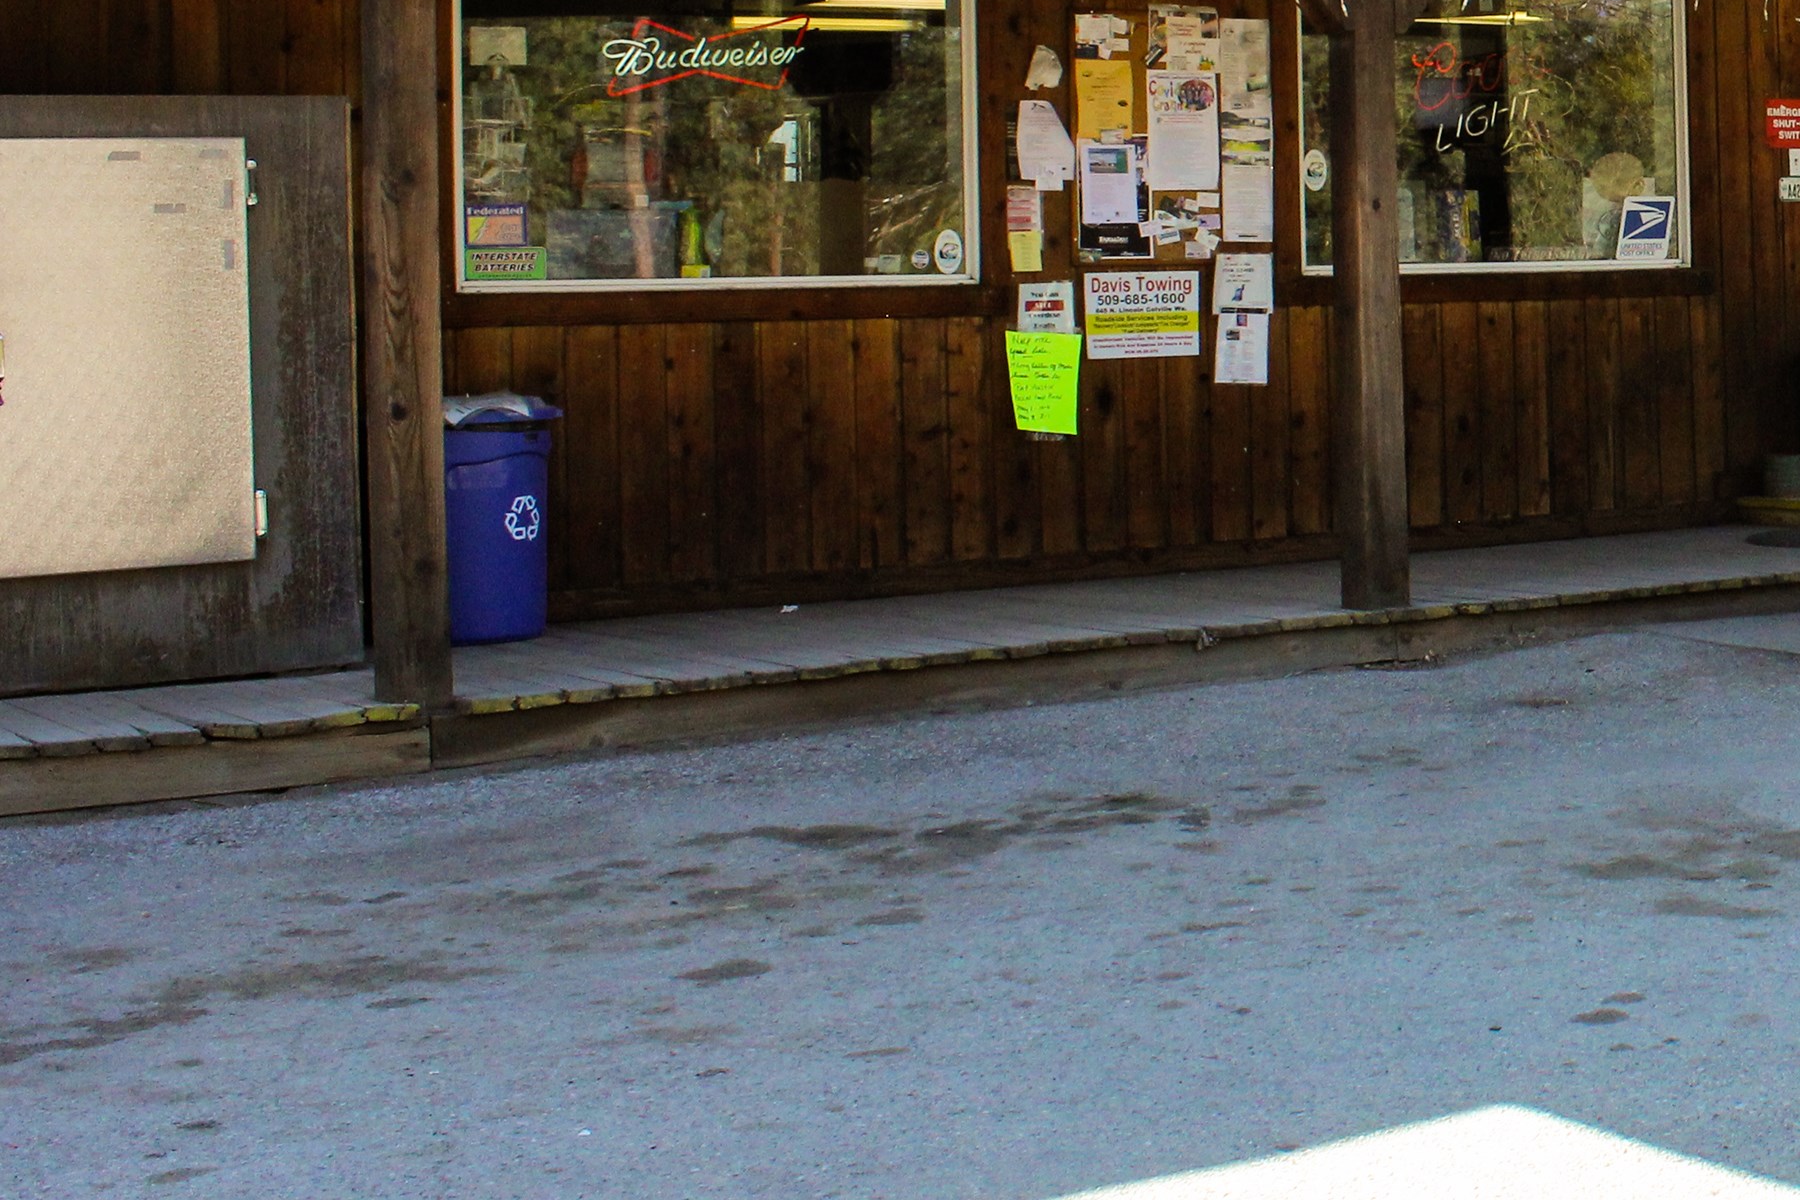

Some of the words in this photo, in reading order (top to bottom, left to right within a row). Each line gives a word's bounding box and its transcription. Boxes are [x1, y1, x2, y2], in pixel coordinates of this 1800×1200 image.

[602, 37, 805, 77] Budweiser
[1436, 88, 1540, 152] LIGHT
[466, 206, 525, 216] Federated
[471, 252, 538, 261] INTERSTATE
[474, 263, 535, 273] BATTERIES
[1091, 277, 1131, 294] Davis
[1135, 276, 1193, 295] Towing
[1097, 293, 1186, 306] 509-685-1600
